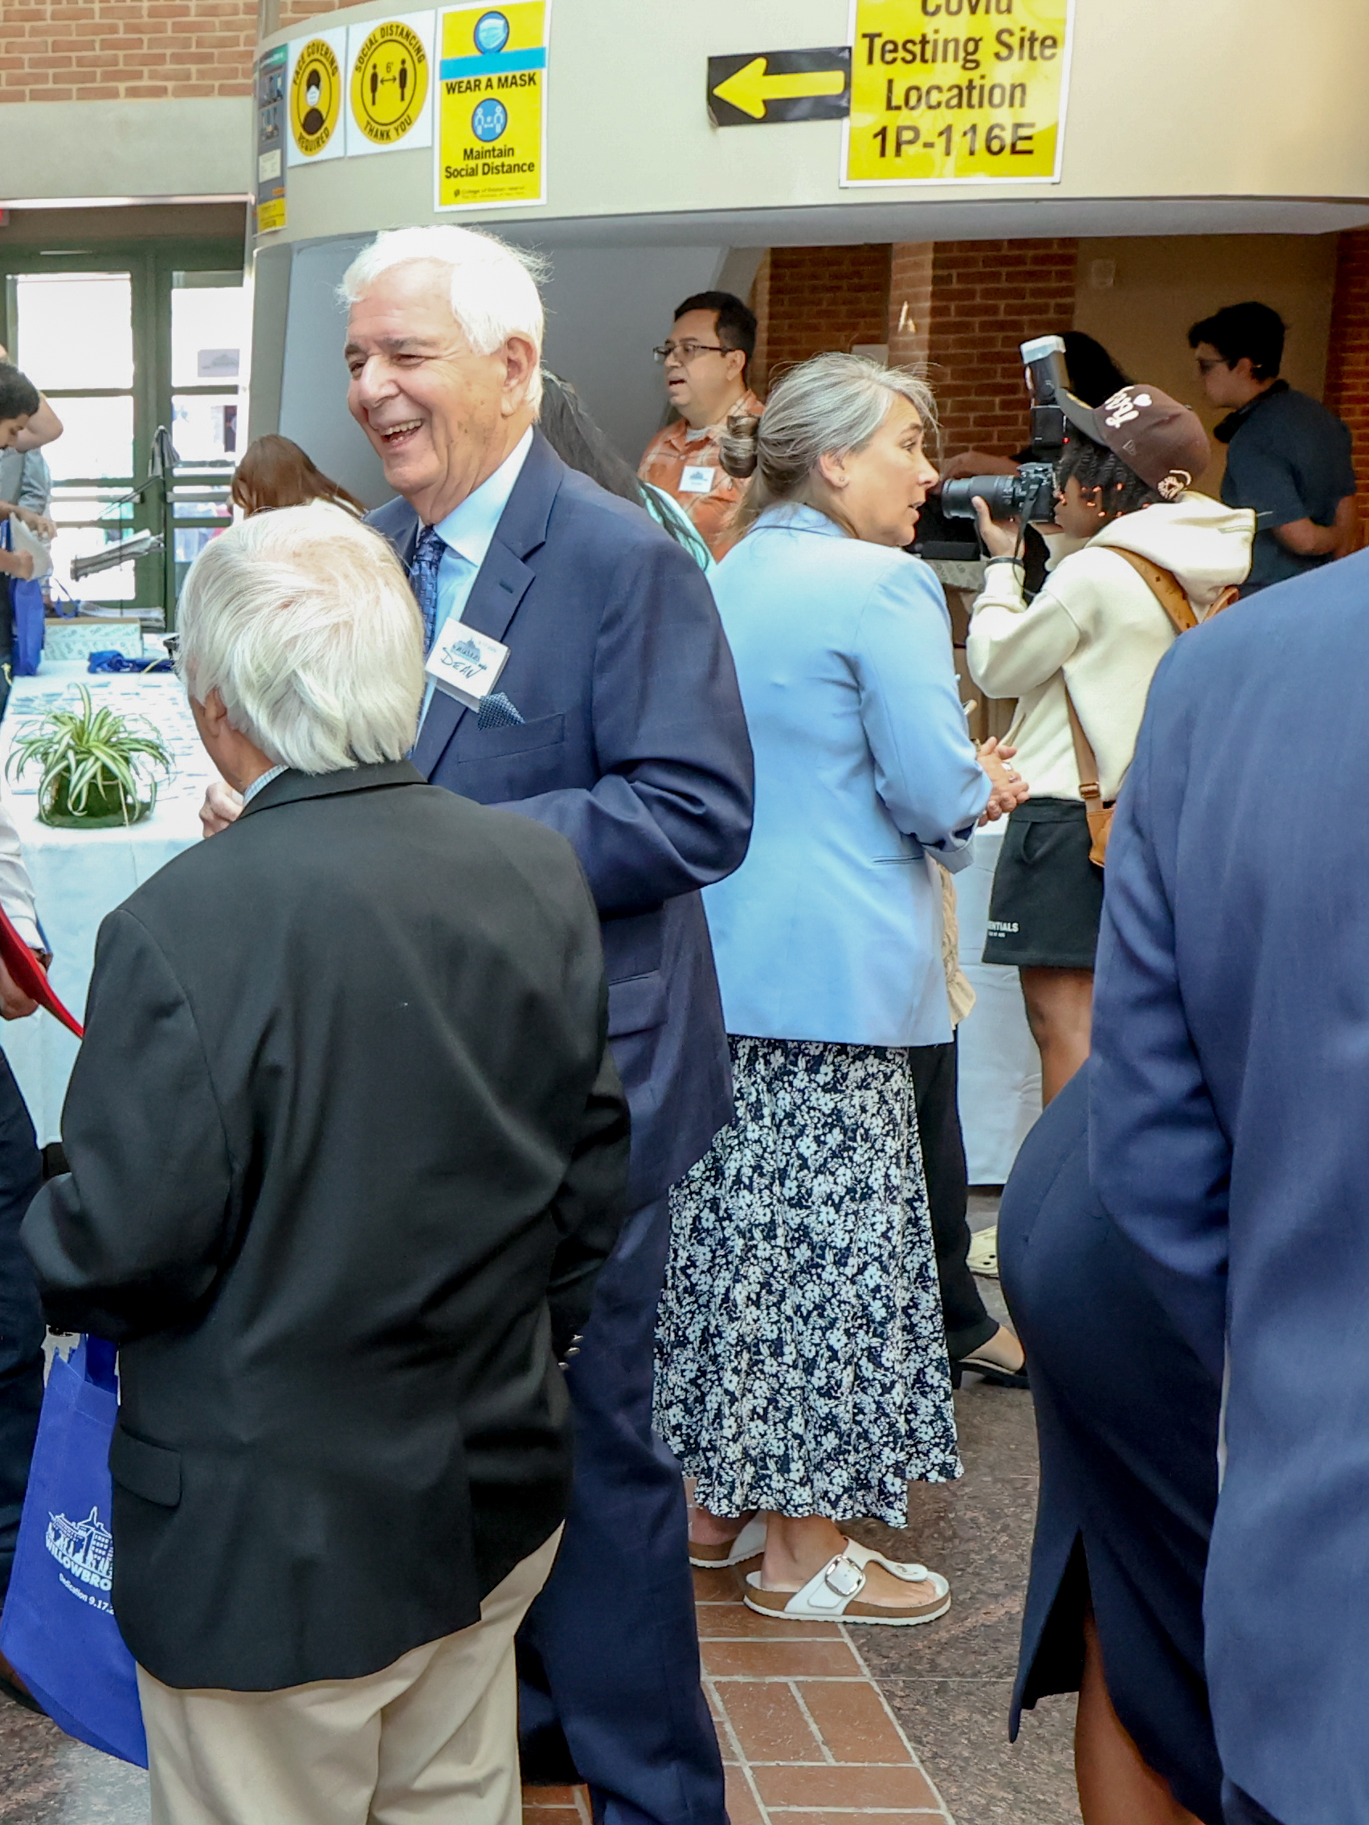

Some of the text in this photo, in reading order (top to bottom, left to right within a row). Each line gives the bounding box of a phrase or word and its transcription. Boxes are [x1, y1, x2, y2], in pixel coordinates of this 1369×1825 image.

[293, 41, 338, 86] FACE COVERING
[355, 24, 425, 73] SOCIAL DISTANCING
[861, 26, 1058, 71] Testing Site
[445, 71, 537, 96] WEAR A MASK
[886, 75, 1027, 112] Location
[298, 126, 330, 152] REQUIRED
[363, 114, 412, 141] THANK YOU
[873, 122, 1036, 158] 1P-116E
[463, 144, 515, 161] Maintain
[445, 161, 535, 179] Social Distance
[440, 646, 483, 679] DEAN
